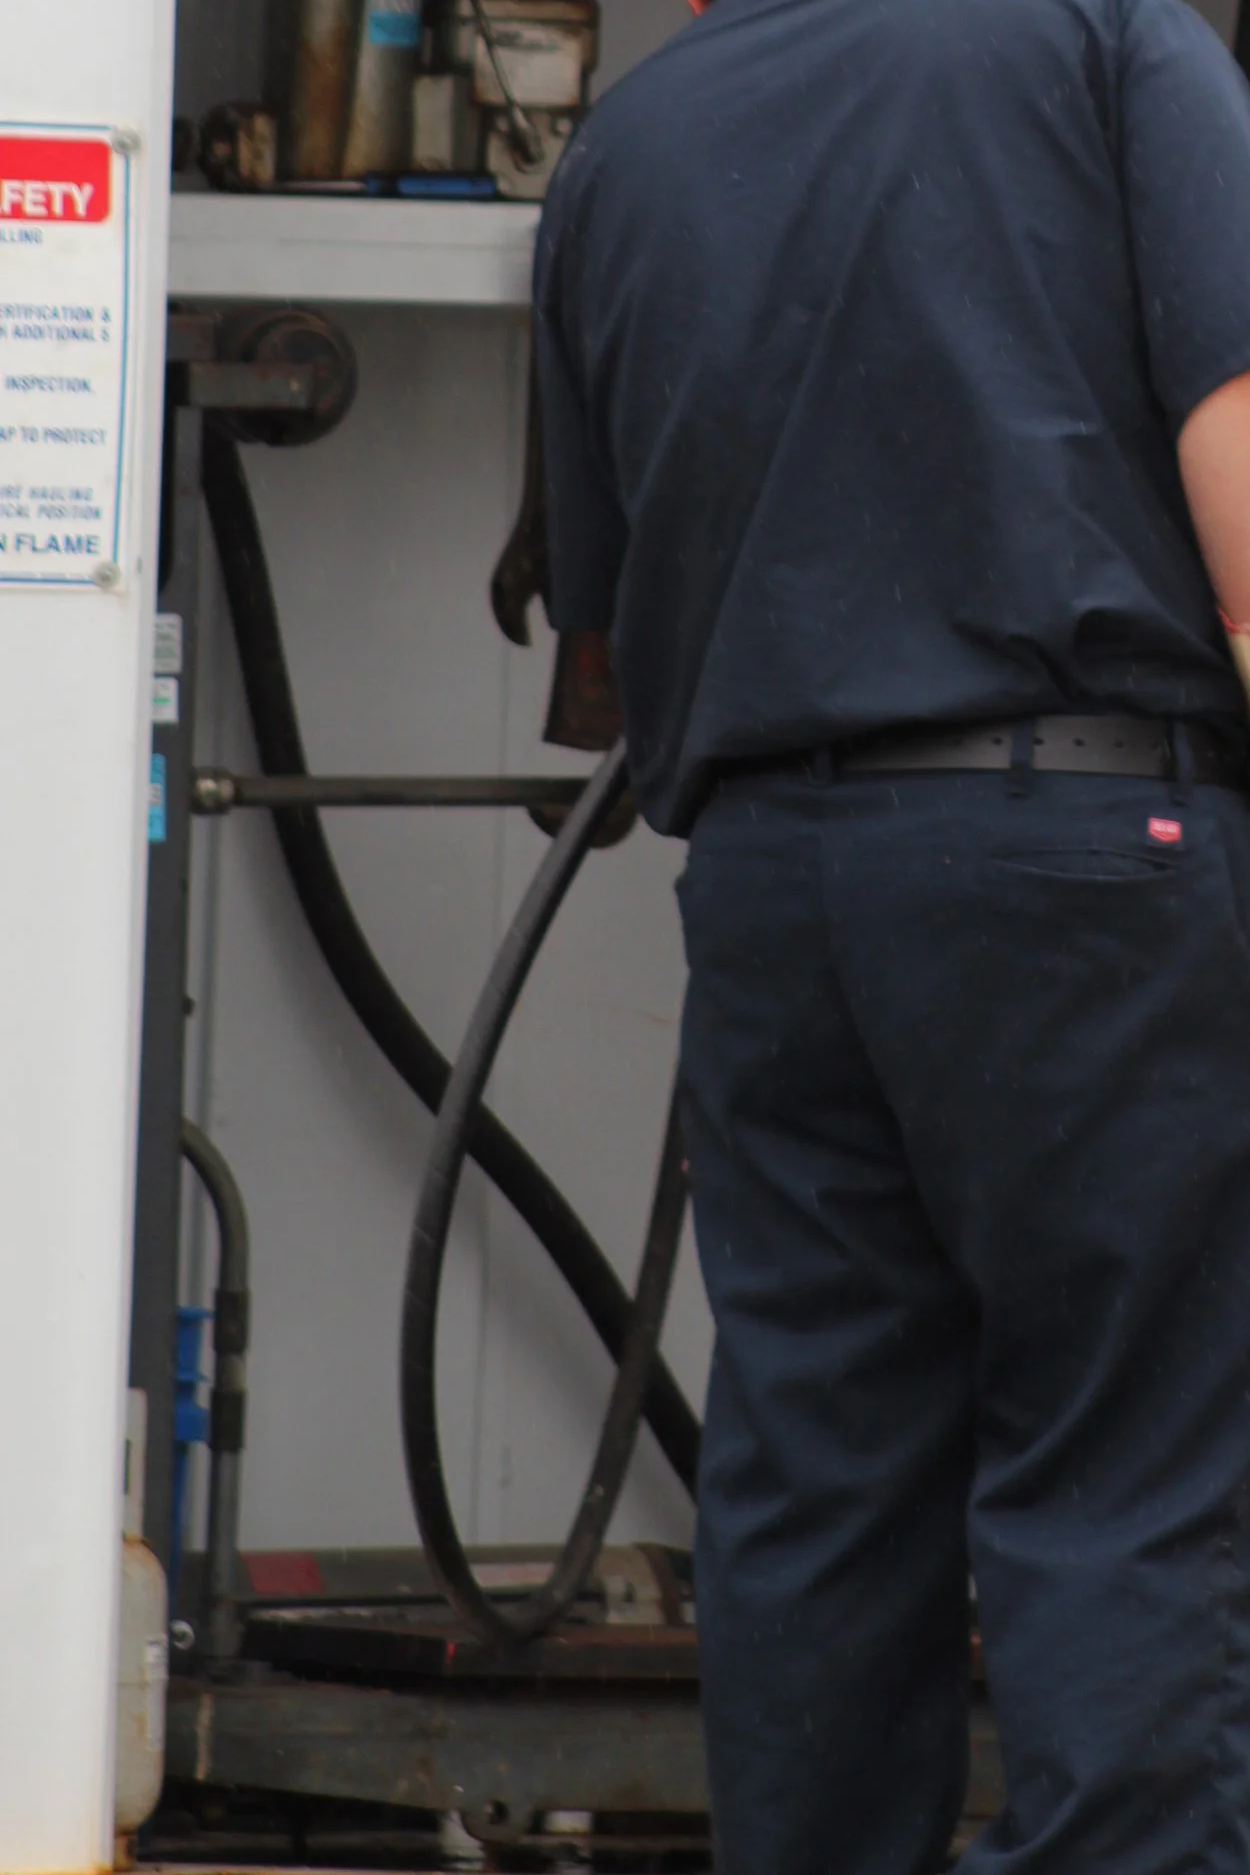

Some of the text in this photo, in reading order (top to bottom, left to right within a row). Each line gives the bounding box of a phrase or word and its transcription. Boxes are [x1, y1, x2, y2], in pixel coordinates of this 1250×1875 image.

[0, 179, 94, 217] FETY
[0, 228, 42, 244] LLING
[13, 324, 97, 341] ADDITIONAL
[21, 427, 40, 443] TO
[44, 429, 106, 445] PROTECT
[15, 533, 101, 555] FLAME
